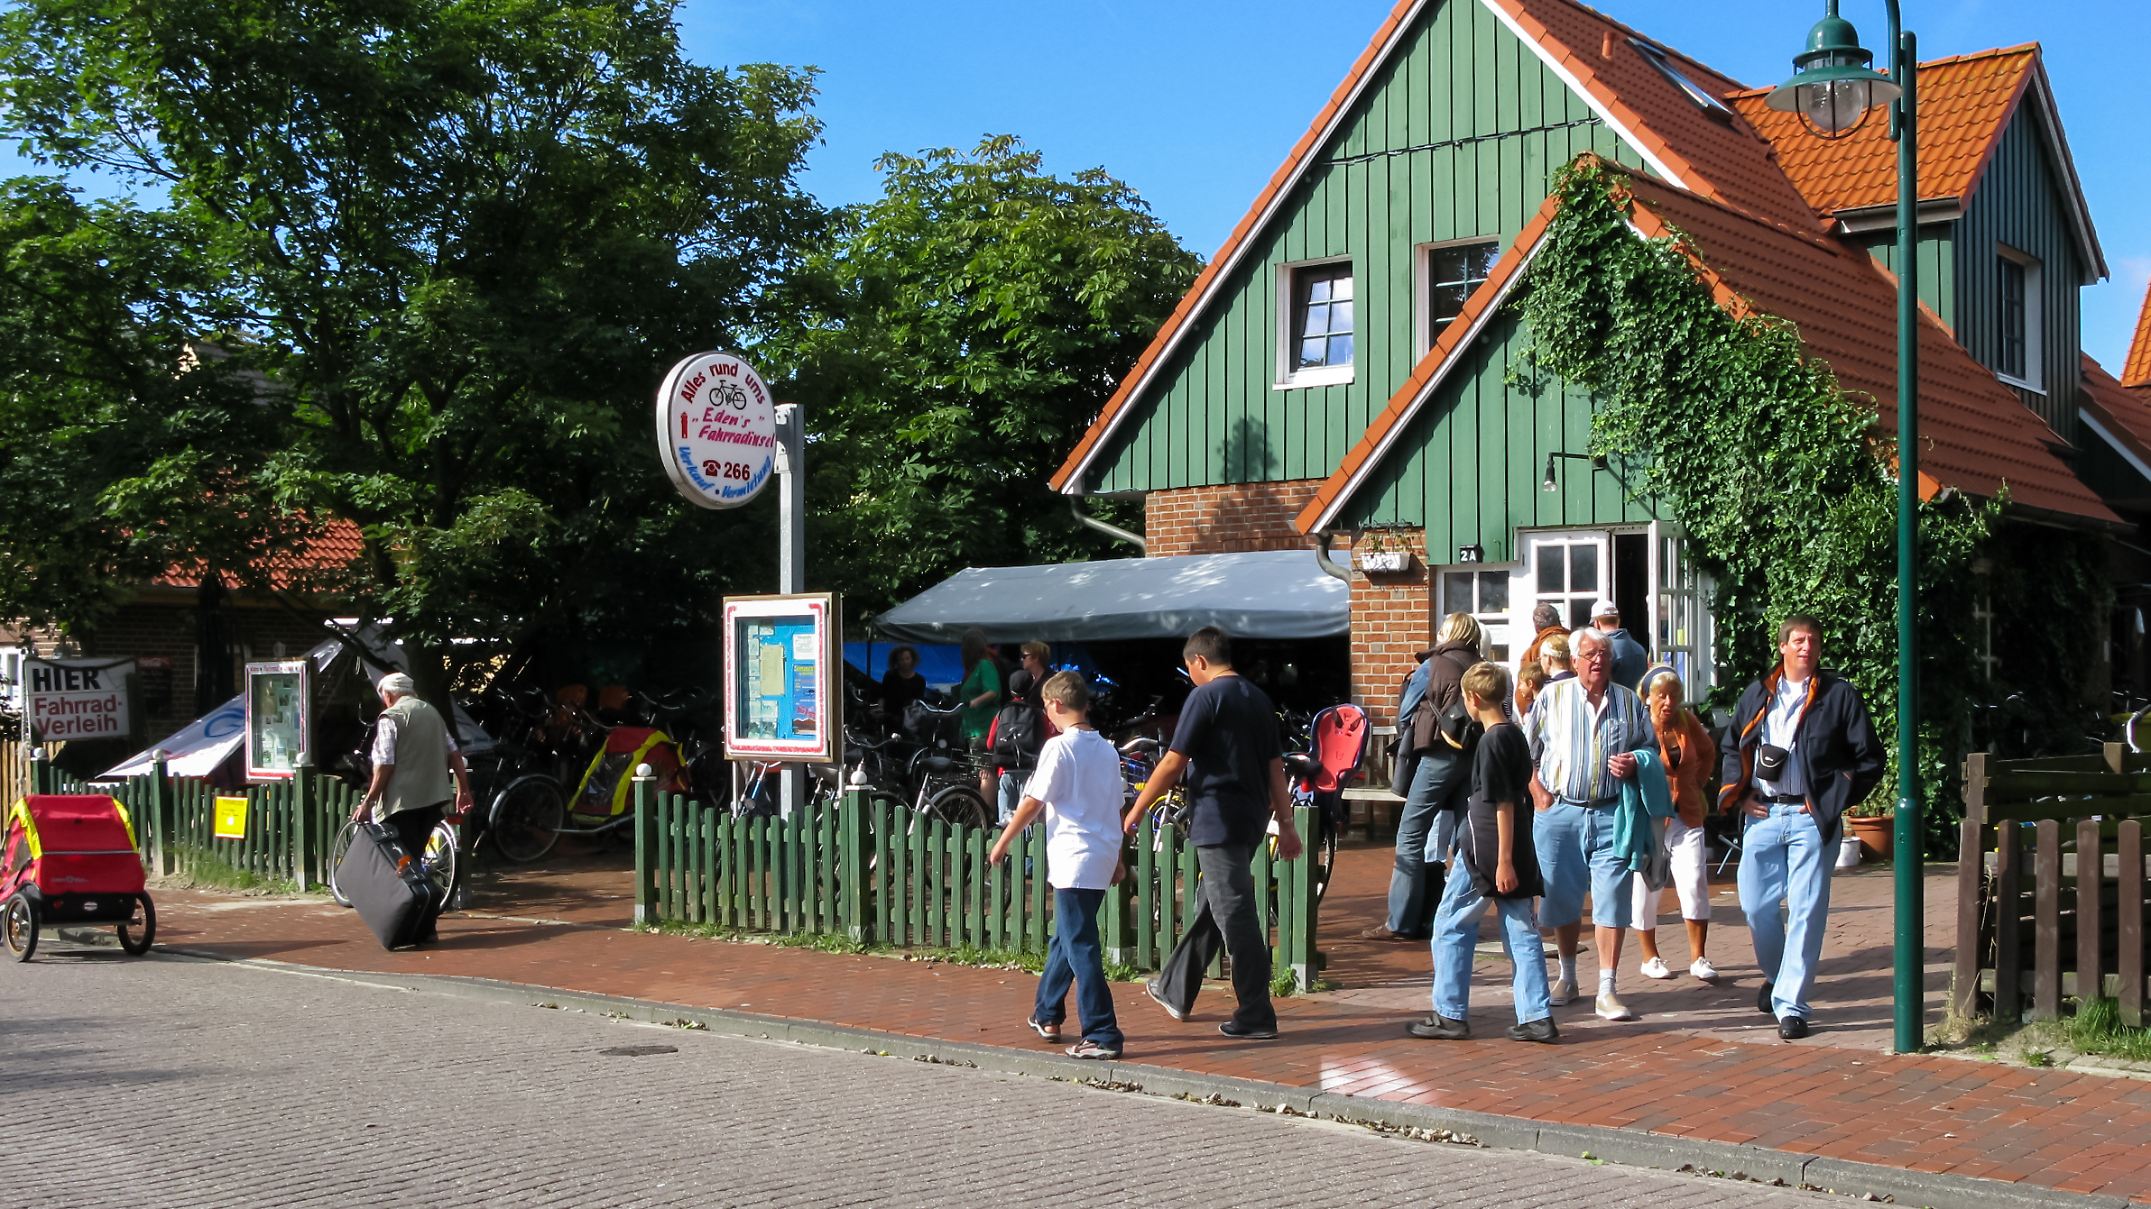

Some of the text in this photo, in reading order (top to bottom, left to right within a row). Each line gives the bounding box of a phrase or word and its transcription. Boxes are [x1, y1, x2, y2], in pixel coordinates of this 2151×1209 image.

[681, 363, 765, 405] Alles rund ums
[698, 426, 775, 449] Fahrradinsel
[678, 446, 715, 491] Verkauf
[724, 462, 750, 481] 266
[1460, 550, 1477, 562] 2A
[32, 667, 101, 692] HIER
[34, 694, 123, 716] Fahrrad-
[36, 714, 118, 736] Verleih
